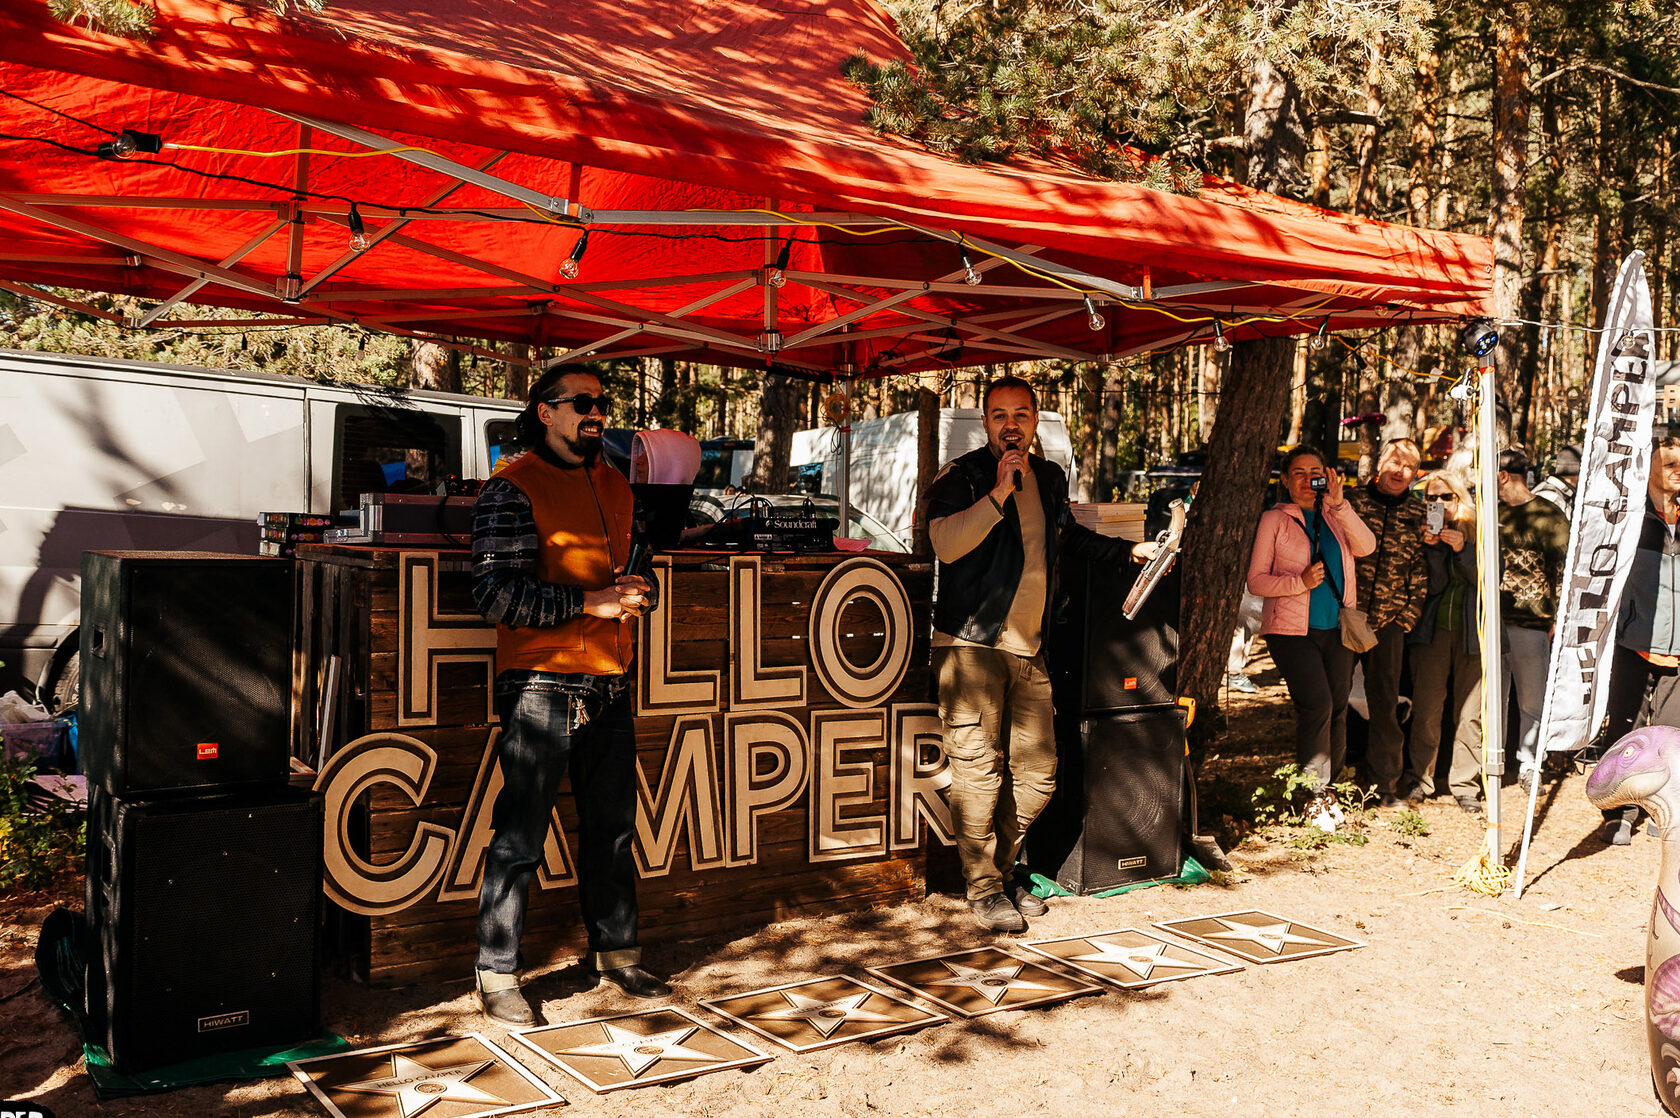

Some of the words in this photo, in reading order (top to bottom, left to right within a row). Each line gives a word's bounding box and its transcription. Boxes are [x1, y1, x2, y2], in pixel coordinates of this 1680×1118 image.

[1603, 332, 1649, 525] CAMPER
[399, 552, 914, 727] HLLO
[203, 1015, 243, 1028] HIWATT
[376, 1078, 414, 1089] HELLO
[415, 1069, 463, 1081] CAMPER
